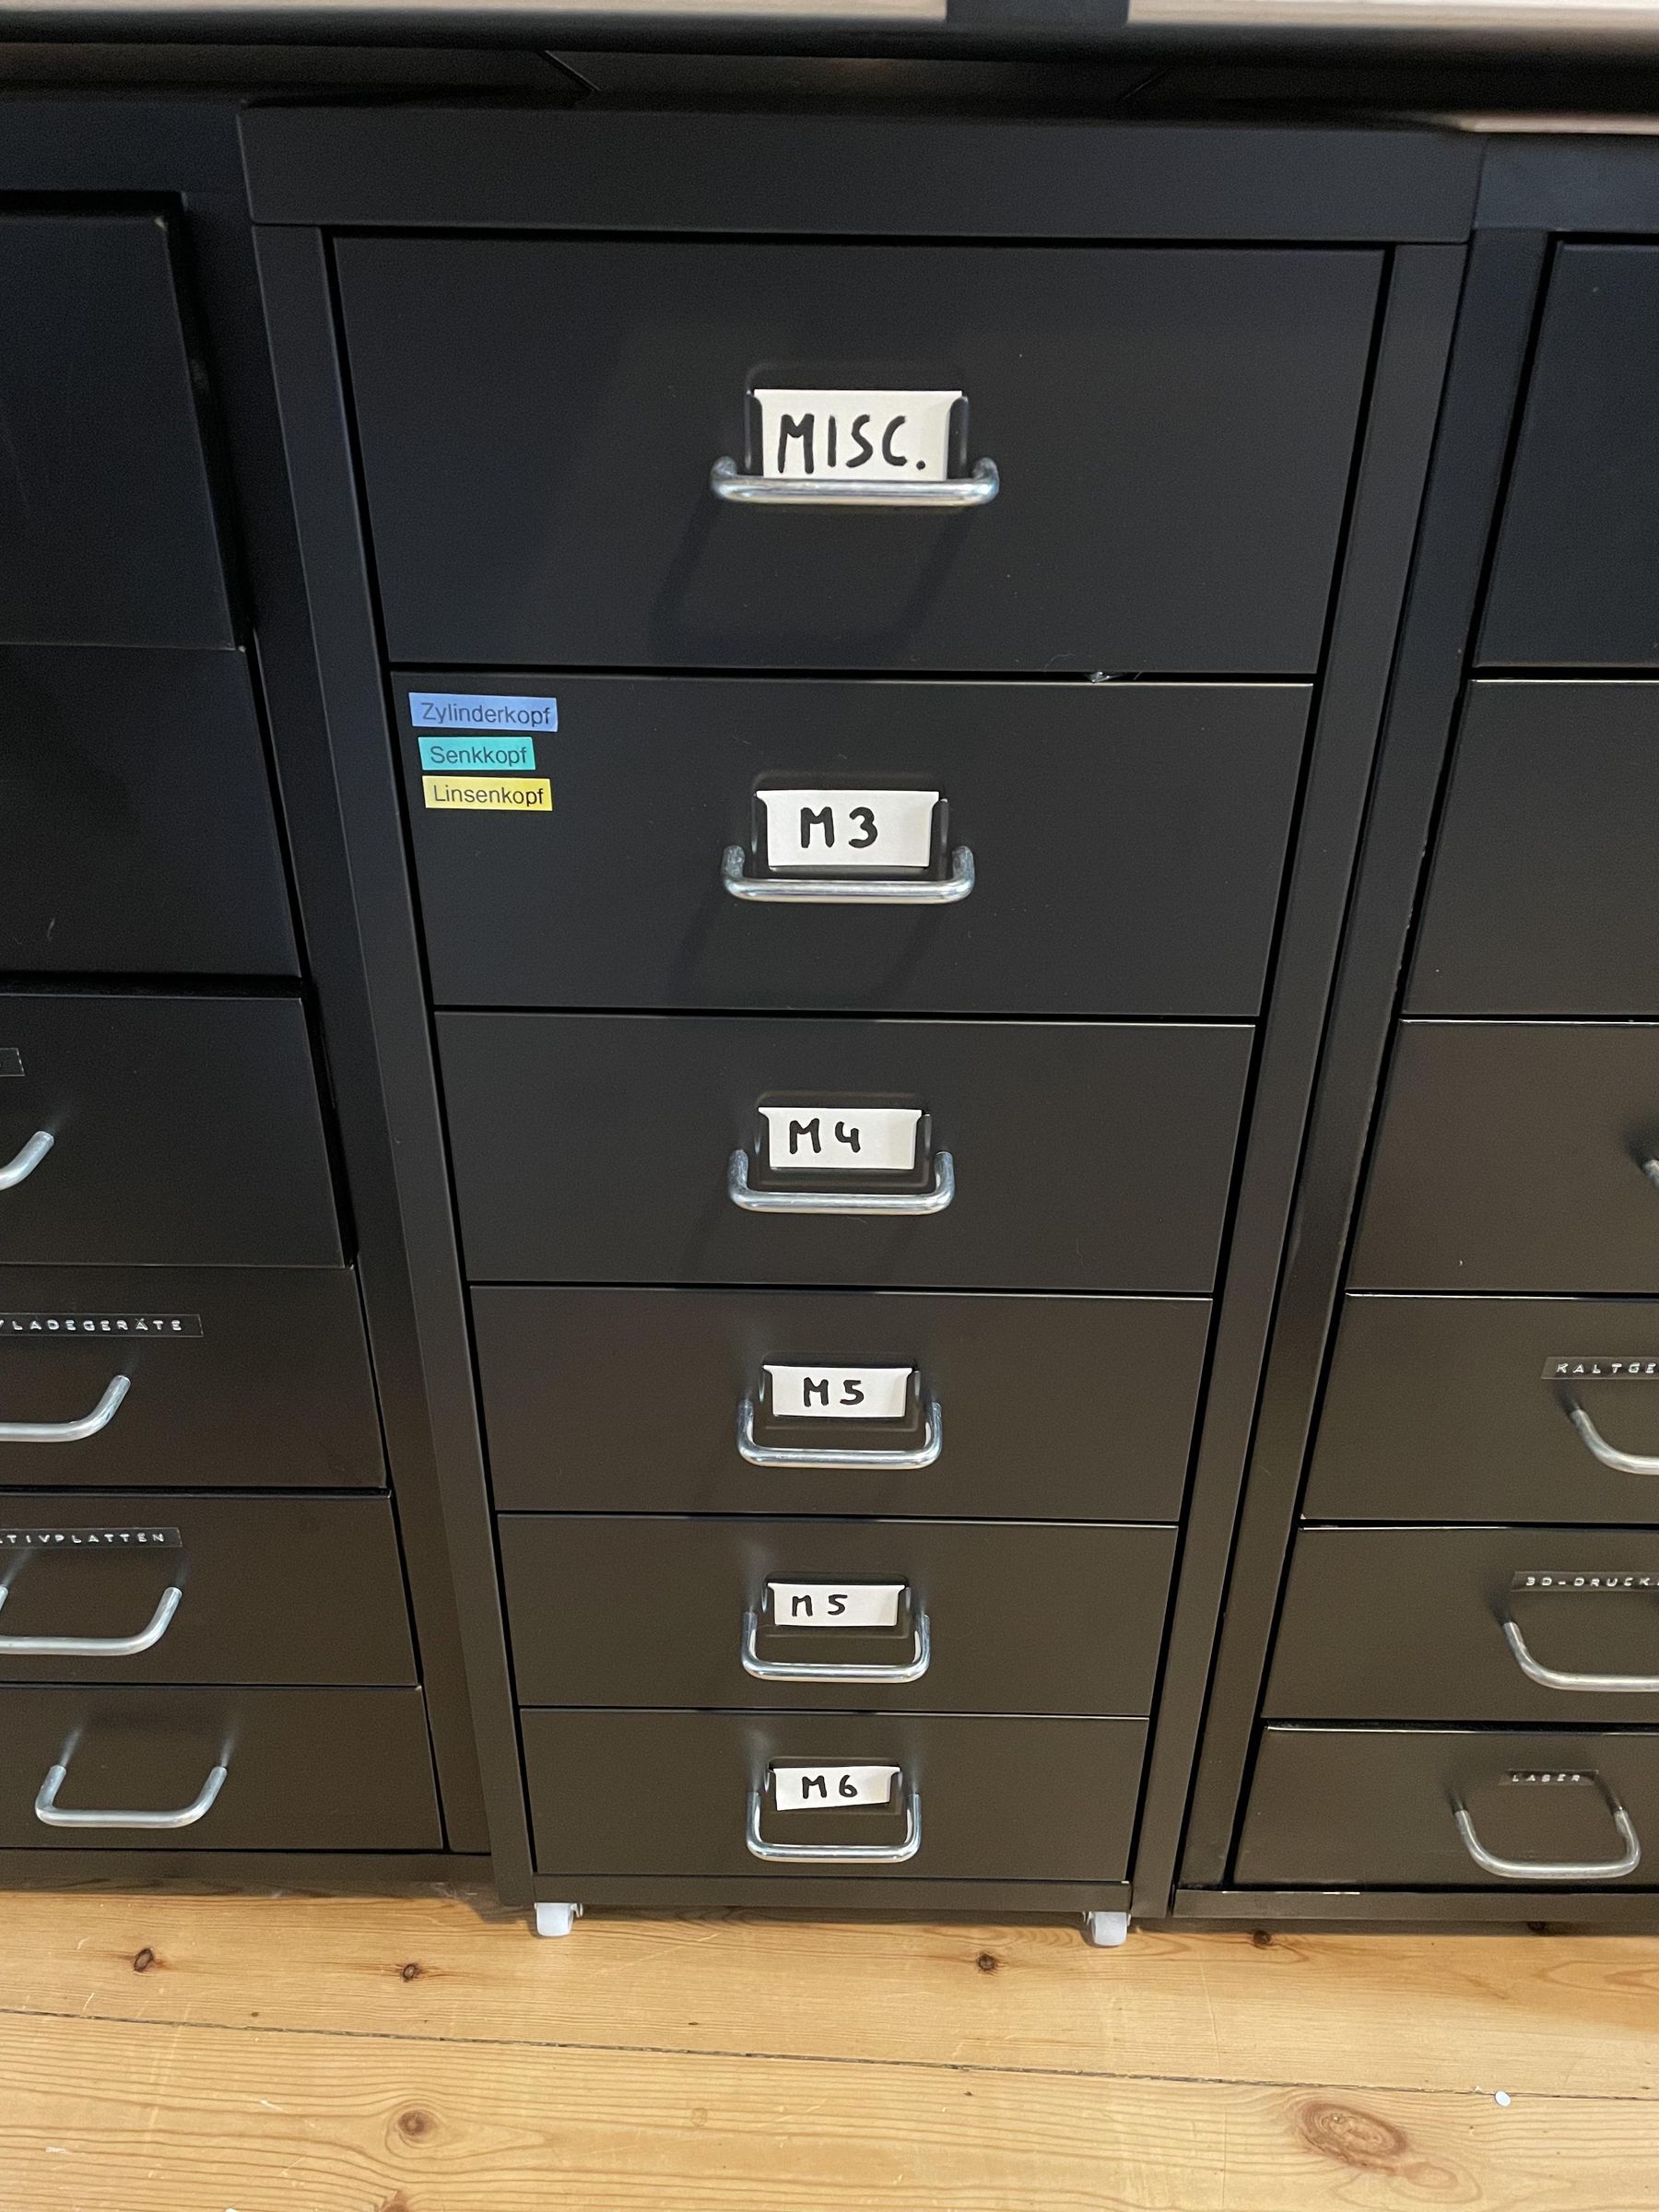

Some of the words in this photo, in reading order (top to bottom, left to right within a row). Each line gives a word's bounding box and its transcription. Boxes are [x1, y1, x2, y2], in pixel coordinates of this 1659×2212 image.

[777, 412, 926, 475] MISC.
[420, 701, 551, 728] Zylinderkopf
[429, 745, 527, 767] Senkkopf
[433, 783, 544, 807] Linsenkopf
[800, 806, 878, 849] M3
[789, 1117, 861, 1155] M4
[1556, 1362, 1656, 1374] KALTGE
[803, 1376, 865, 1407] M5
[0, 1534, 165, 1544] TIVPLATTEN
[1525, 1576, 1659, 1587] 3D-DRUCK
[801, 1774, 858, 1800] M6
[1512, 1773, 1581, 1783] LASER
